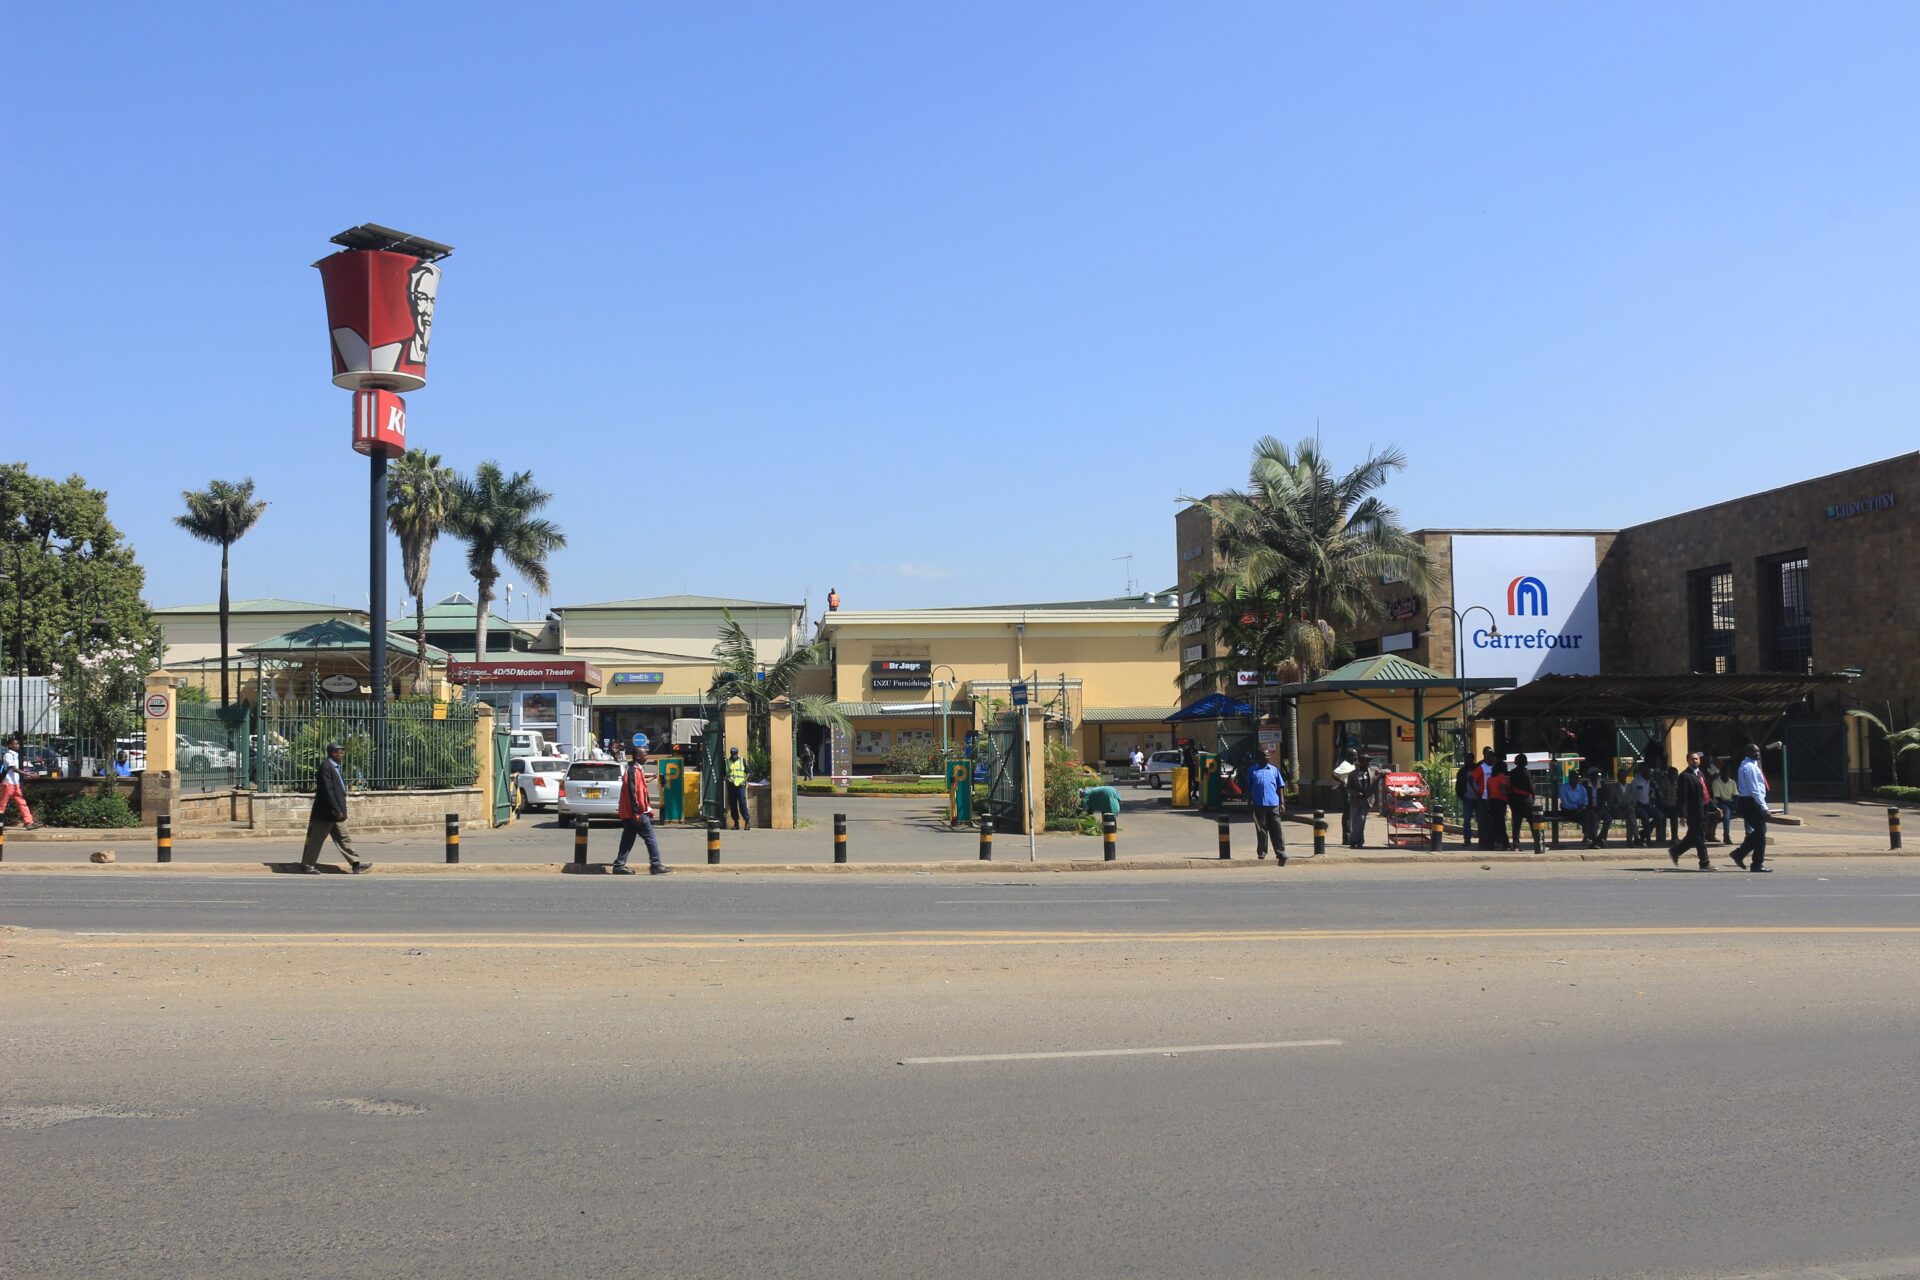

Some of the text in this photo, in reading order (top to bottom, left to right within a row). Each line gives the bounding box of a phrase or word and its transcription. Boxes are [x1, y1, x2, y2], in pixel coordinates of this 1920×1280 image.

[1473, 629, 1583, 649] Carrefour
[516, 668, 543, 677] Motion
[545, 668, 575, 676] Theater
